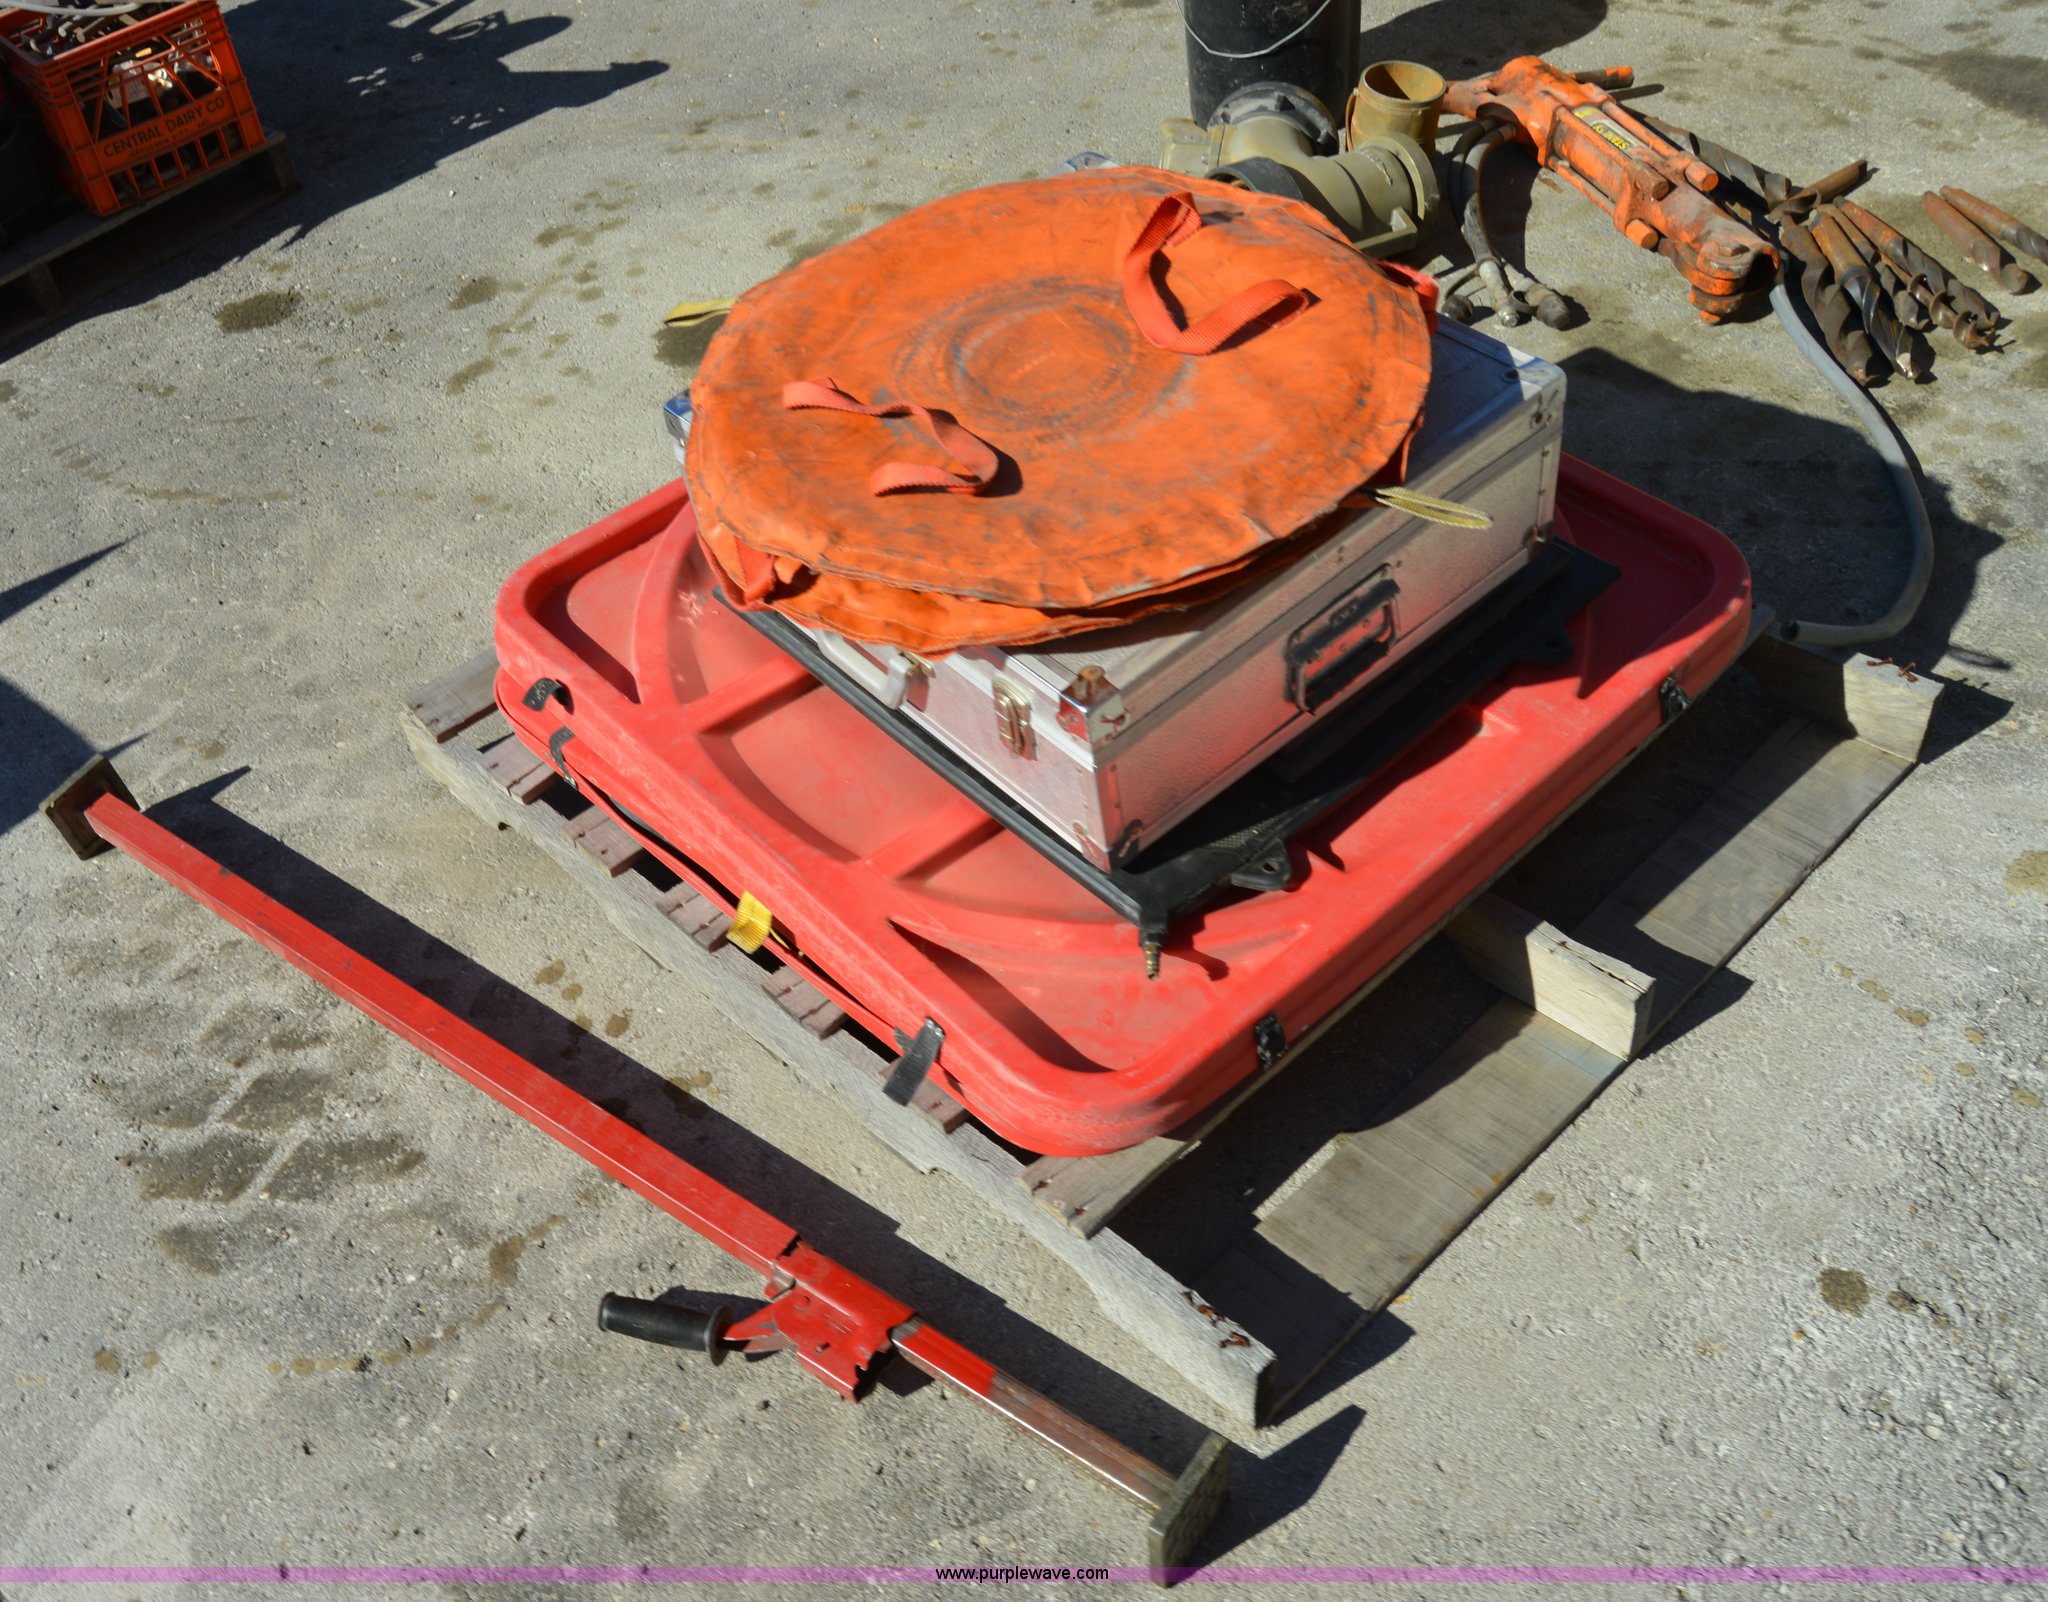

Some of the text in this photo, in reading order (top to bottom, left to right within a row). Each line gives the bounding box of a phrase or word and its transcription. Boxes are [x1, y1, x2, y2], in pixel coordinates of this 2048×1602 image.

[103, 126, 162, 157] CENTRAL
[166, 105, 203, 132] DAIRY
[206, 97, 225, 113] CO
[1593, 124, 1630, 151] STANEY
